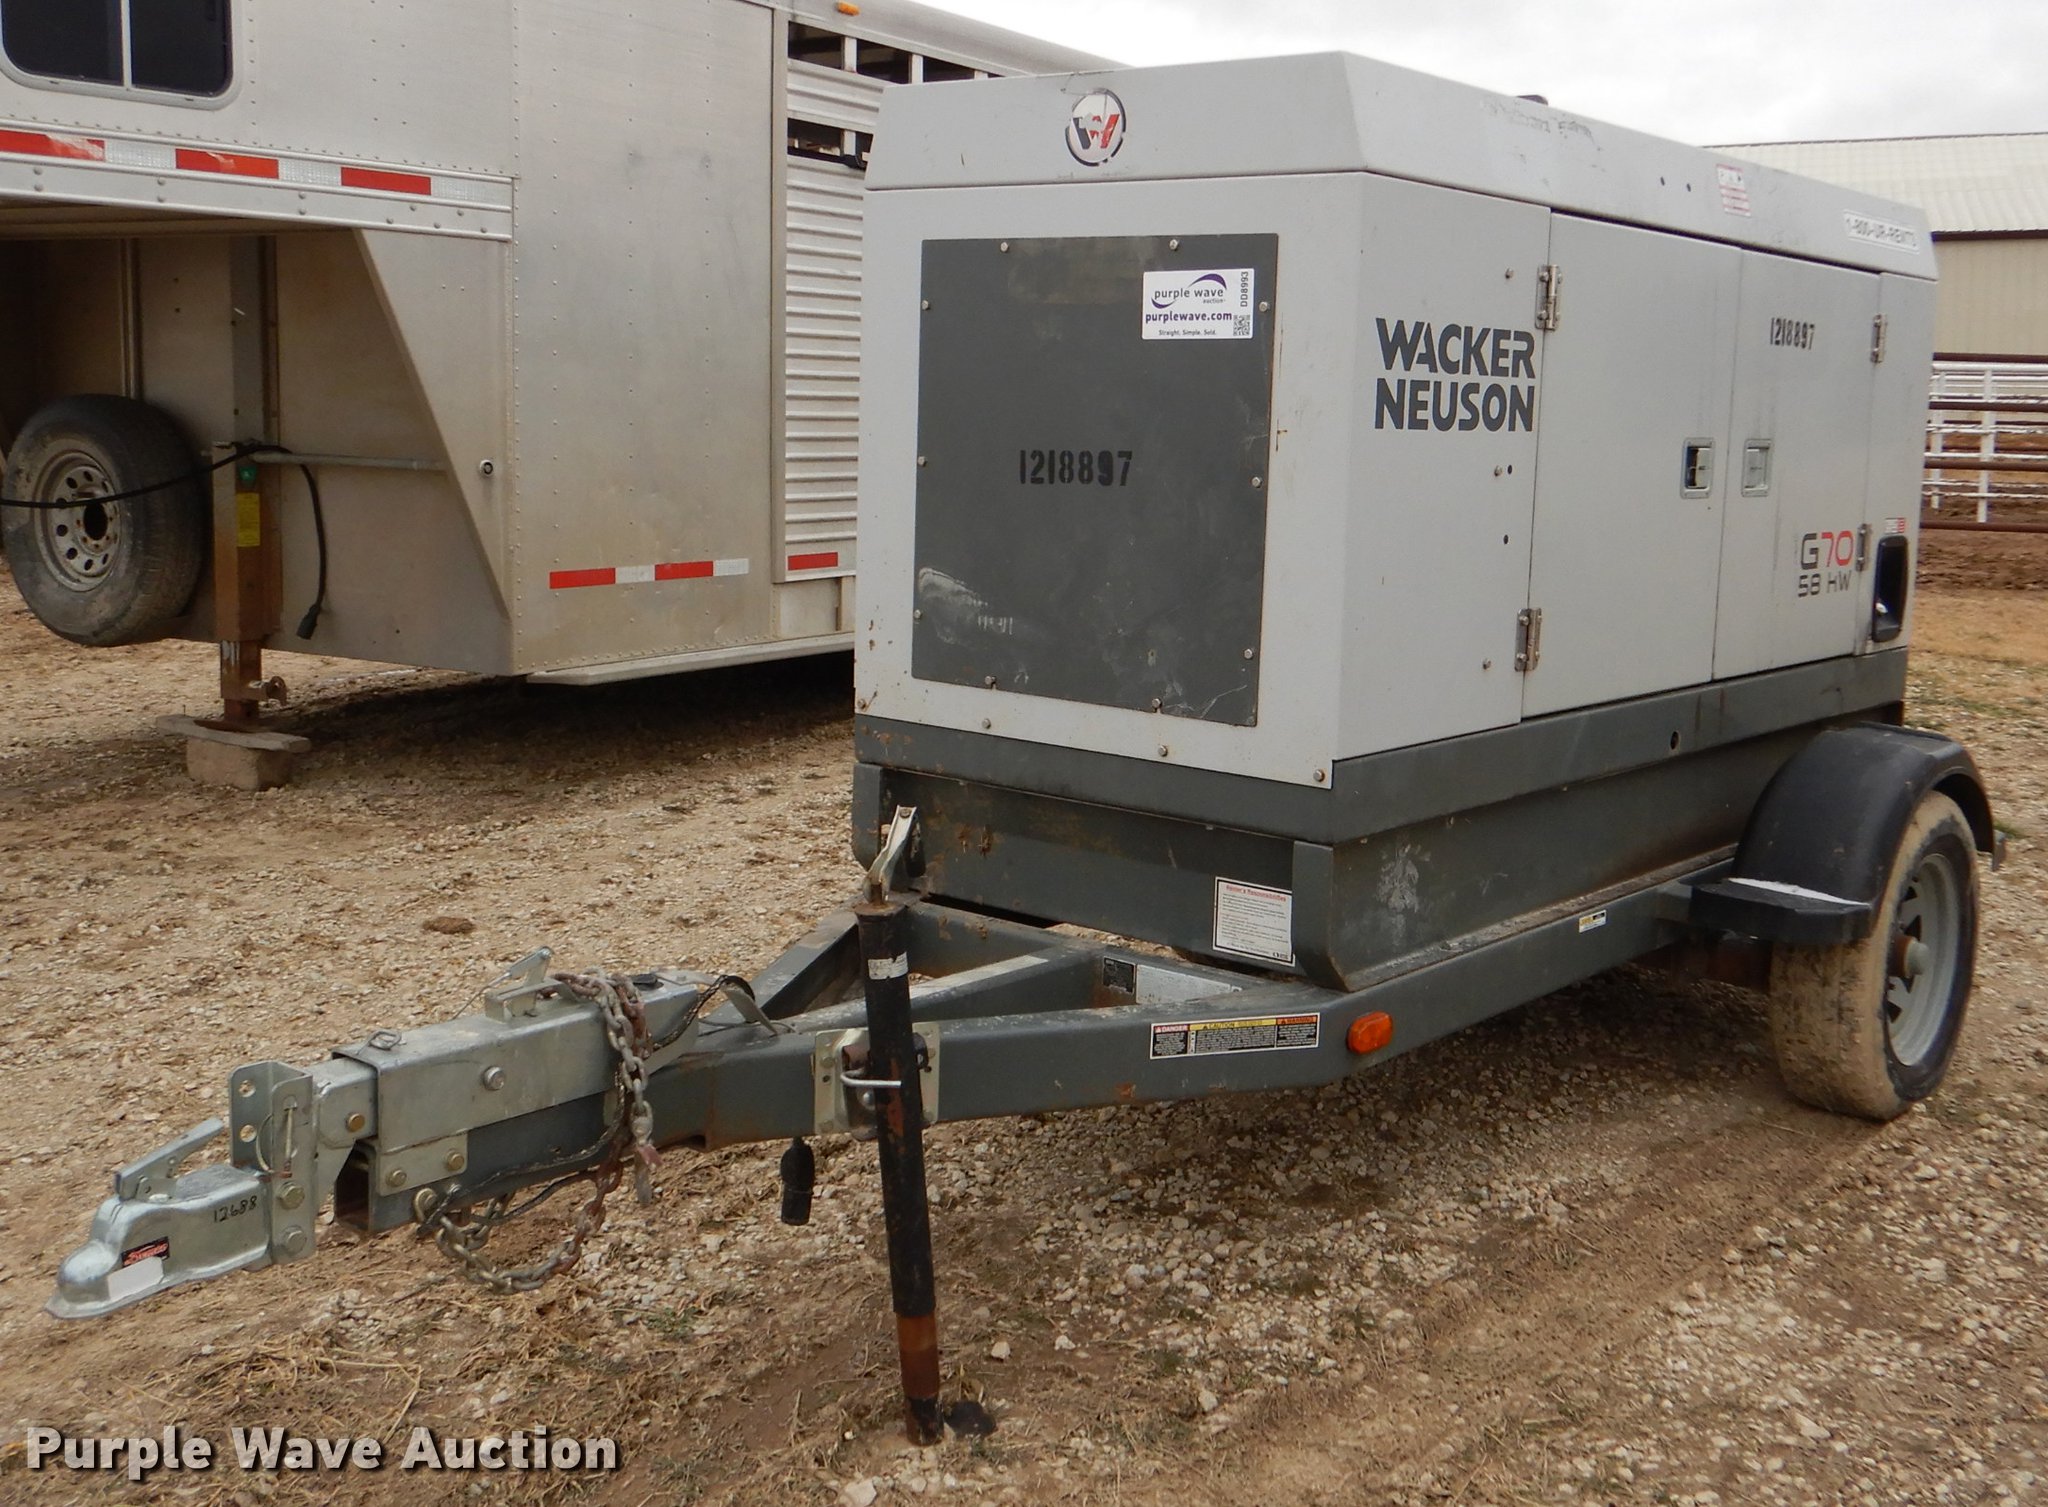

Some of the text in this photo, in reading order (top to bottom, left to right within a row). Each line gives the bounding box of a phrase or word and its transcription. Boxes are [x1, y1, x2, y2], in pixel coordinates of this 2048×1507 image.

[1155, 288, 1224, 300] purple wave
[1145, 311, 1233, 324] purplewave.com
[1770, 317, 1815, 350] 1218897
[1375, 317, 1536, 379] WACKER
[1375, 378, 1535, 432] NEUSON
[1019, 450, 1133, 487] 1218897
[1801, 530, 1854, 570] G70
[213, 1195, 258, 1223] 12688
